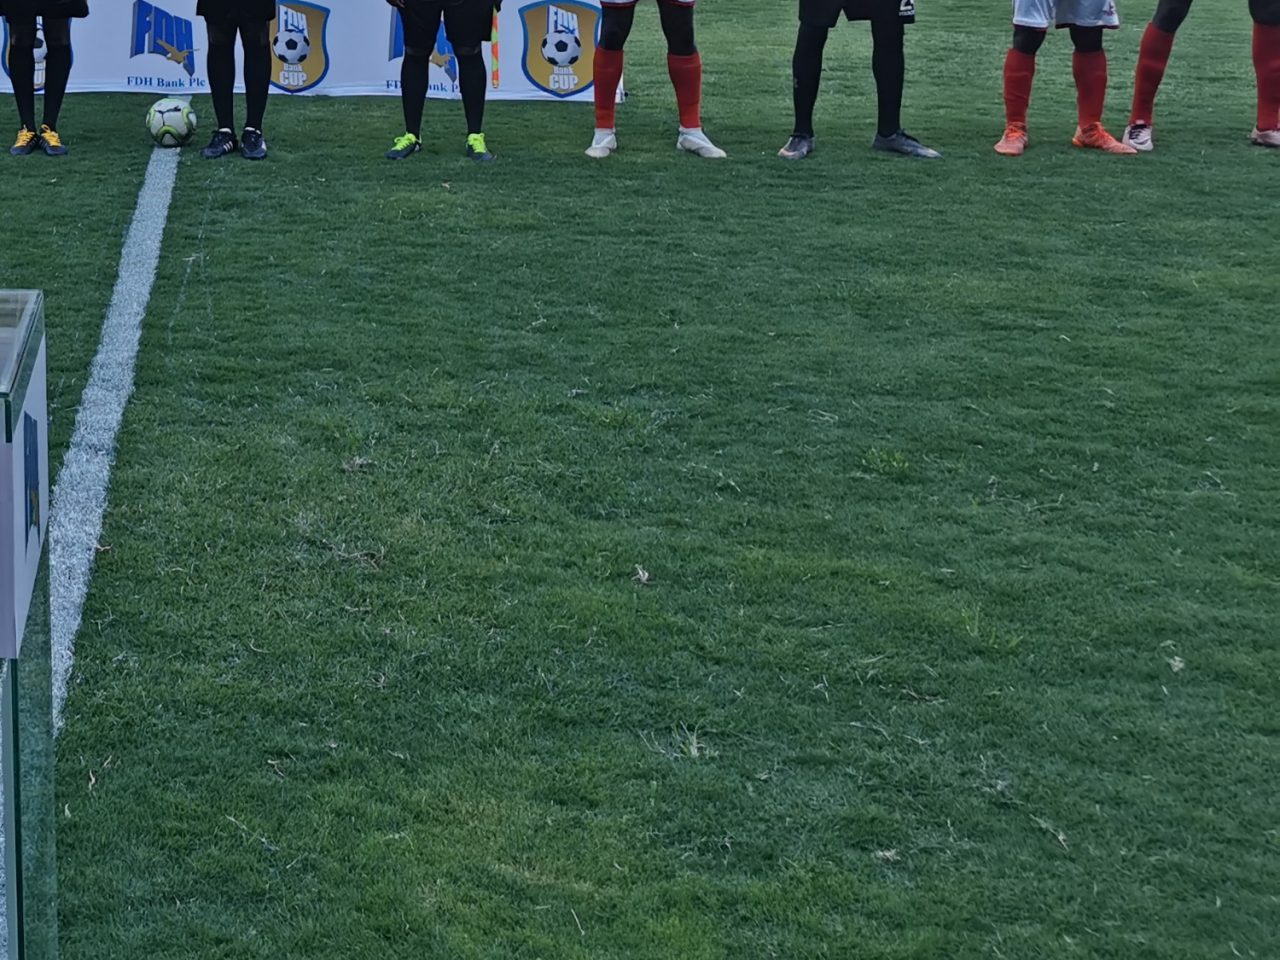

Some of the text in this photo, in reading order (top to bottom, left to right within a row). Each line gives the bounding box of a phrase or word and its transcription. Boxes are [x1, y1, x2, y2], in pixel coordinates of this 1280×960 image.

[130, 0, 195, 78] FDH
[127, 77, 206, 90] FDH Bank Plc
[279, 72, 308, 88] CUP
[549, 74, 578, 90] CUP
